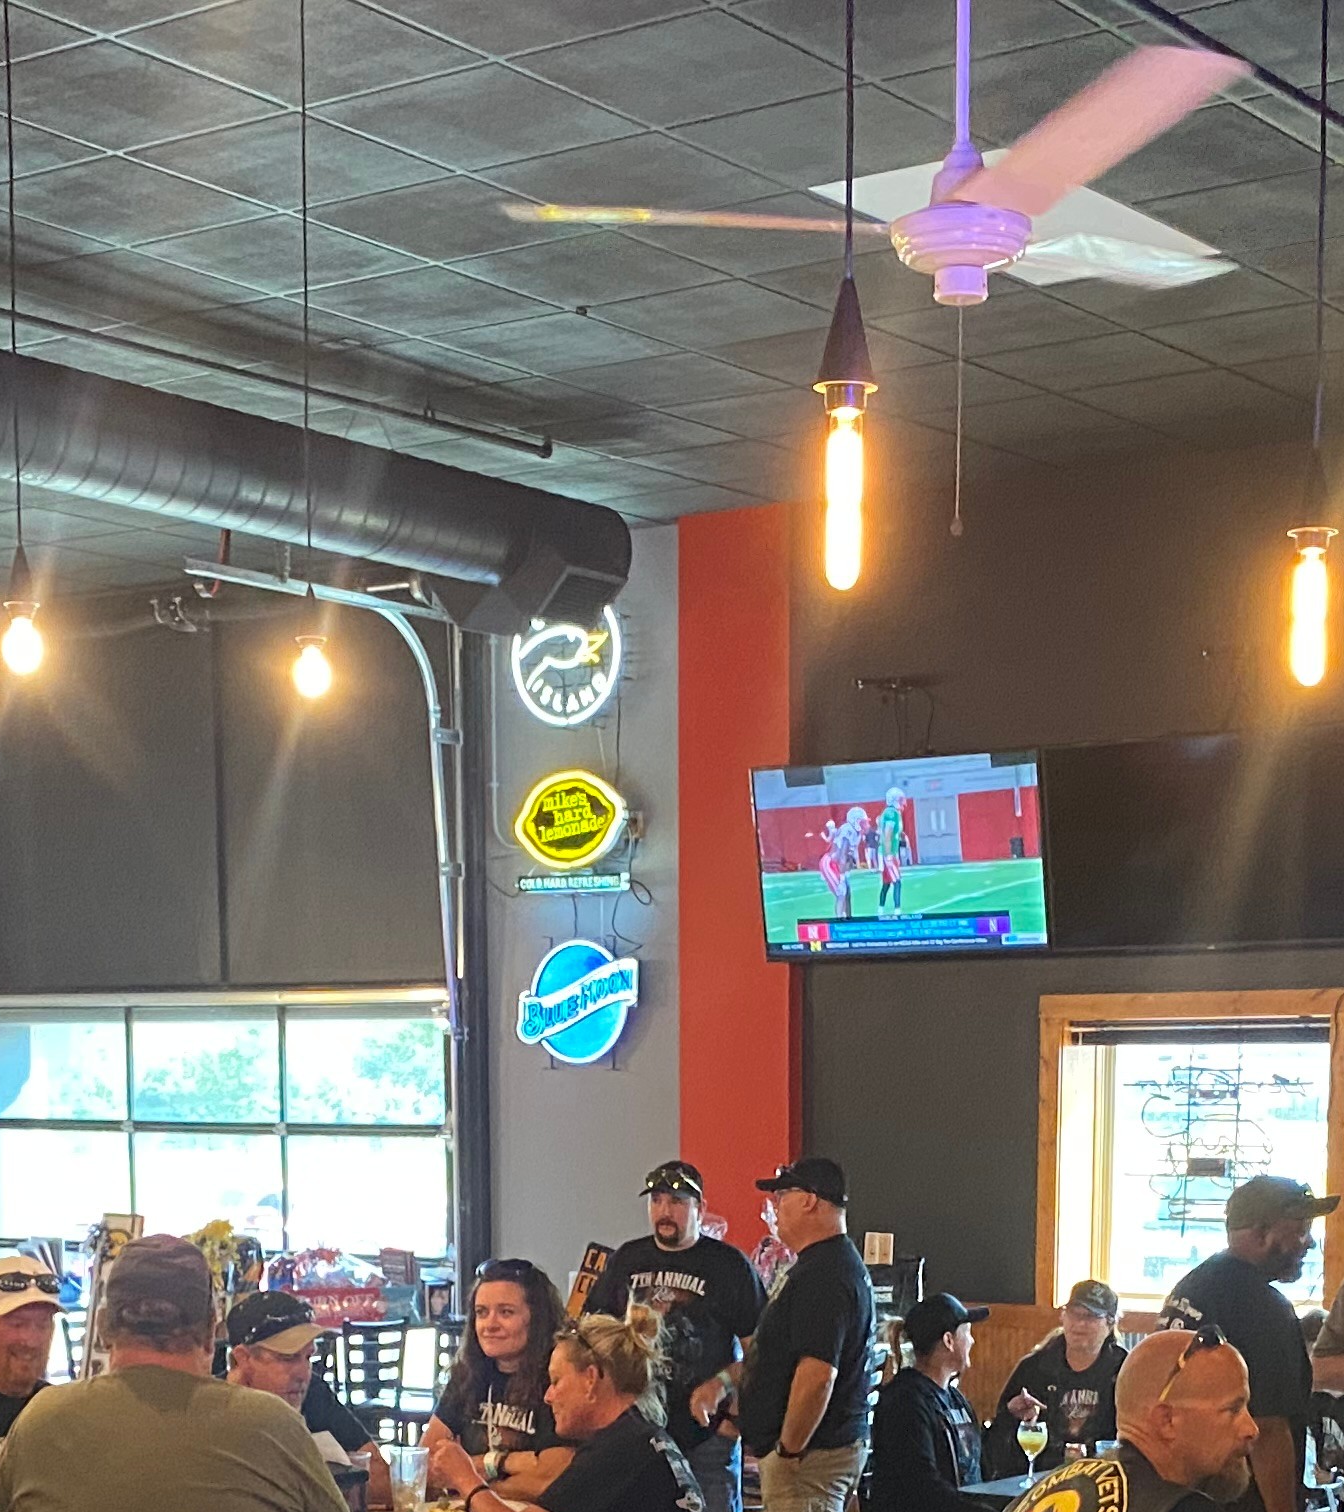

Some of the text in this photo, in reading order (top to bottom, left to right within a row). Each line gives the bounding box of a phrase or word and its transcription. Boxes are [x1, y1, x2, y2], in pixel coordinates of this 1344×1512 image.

[542, 791, 588, 812] mike's
[553, 804, 593, 823] hard
[538, 815, 605, 844] lemonade
[655, 1273, 705, 1297] ANNUAL
